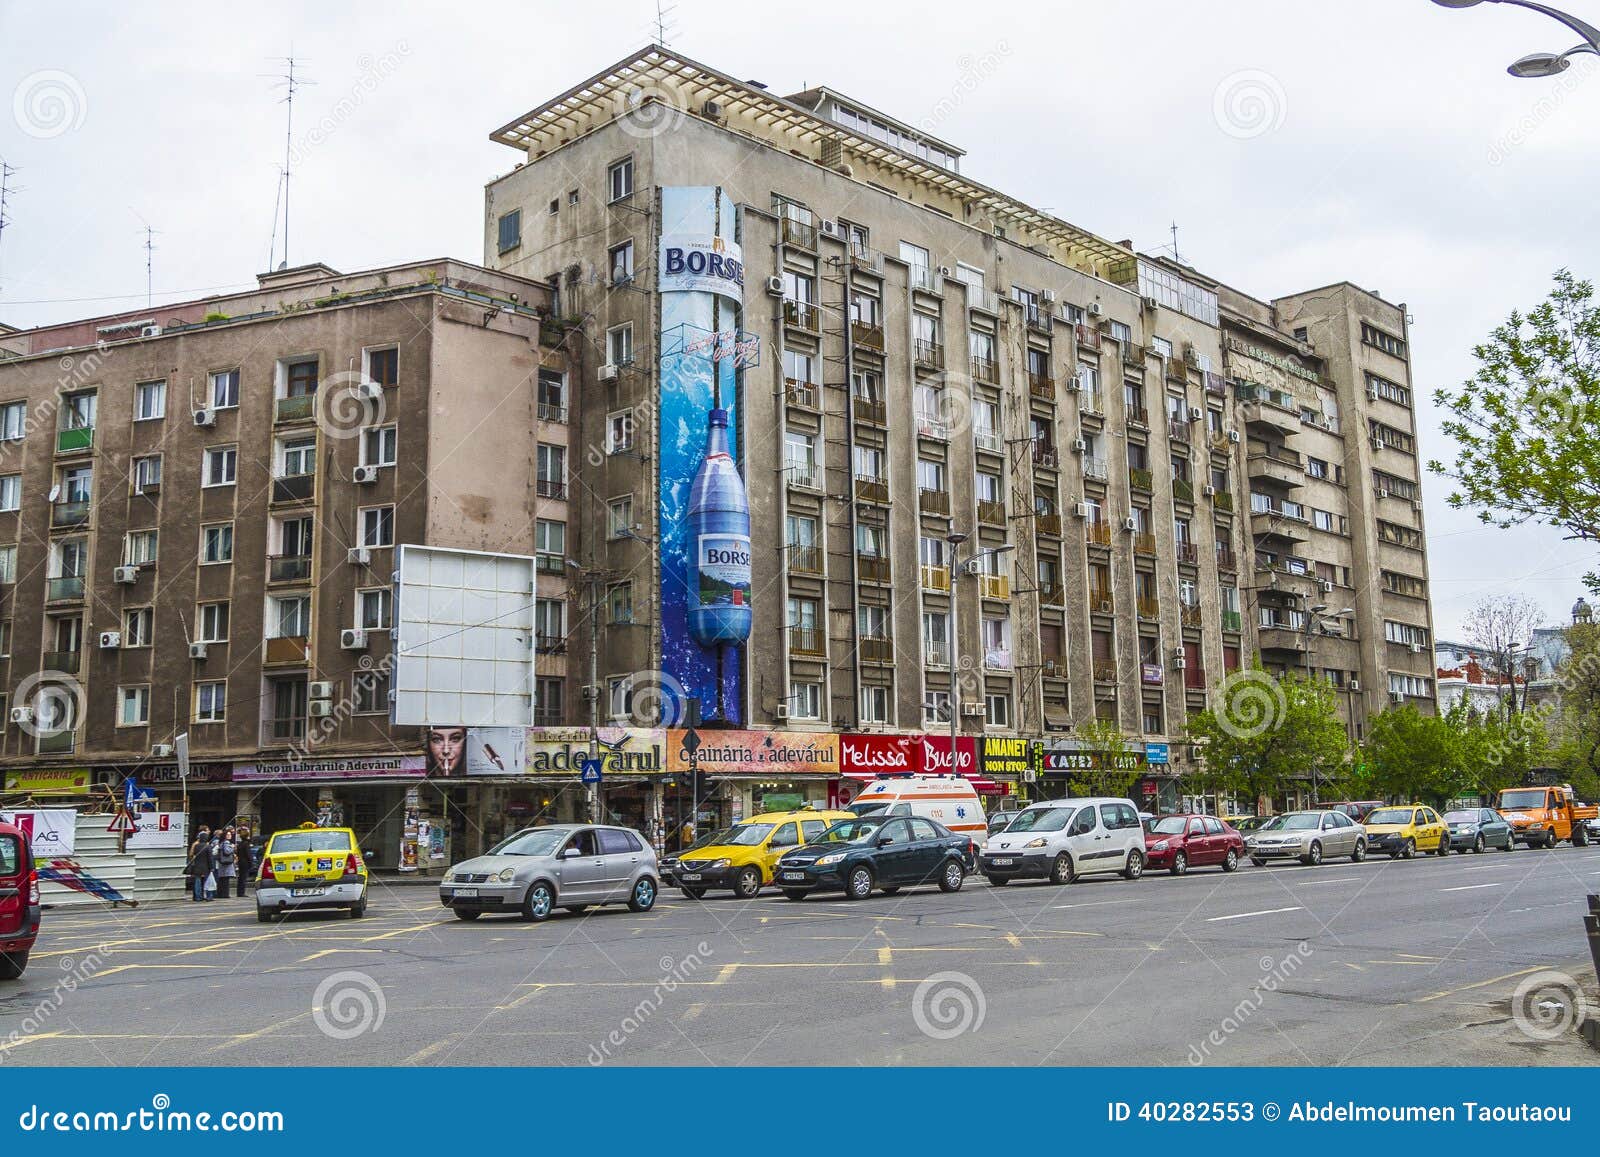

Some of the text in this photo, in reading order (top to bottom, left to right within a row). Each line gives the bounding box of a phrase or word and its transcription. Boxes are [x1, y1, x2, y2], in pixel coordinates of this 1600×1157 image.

[842, 741, 908, 767] Melissa
[984, 738, 1027, 757] AMANET
[923, 740, 971, 771] Bueno
[985, 761, 1027, 772] NON STOP
[21, 769, 73, 781] ANTICARIAT
[35, 830, 59, 842] AG
